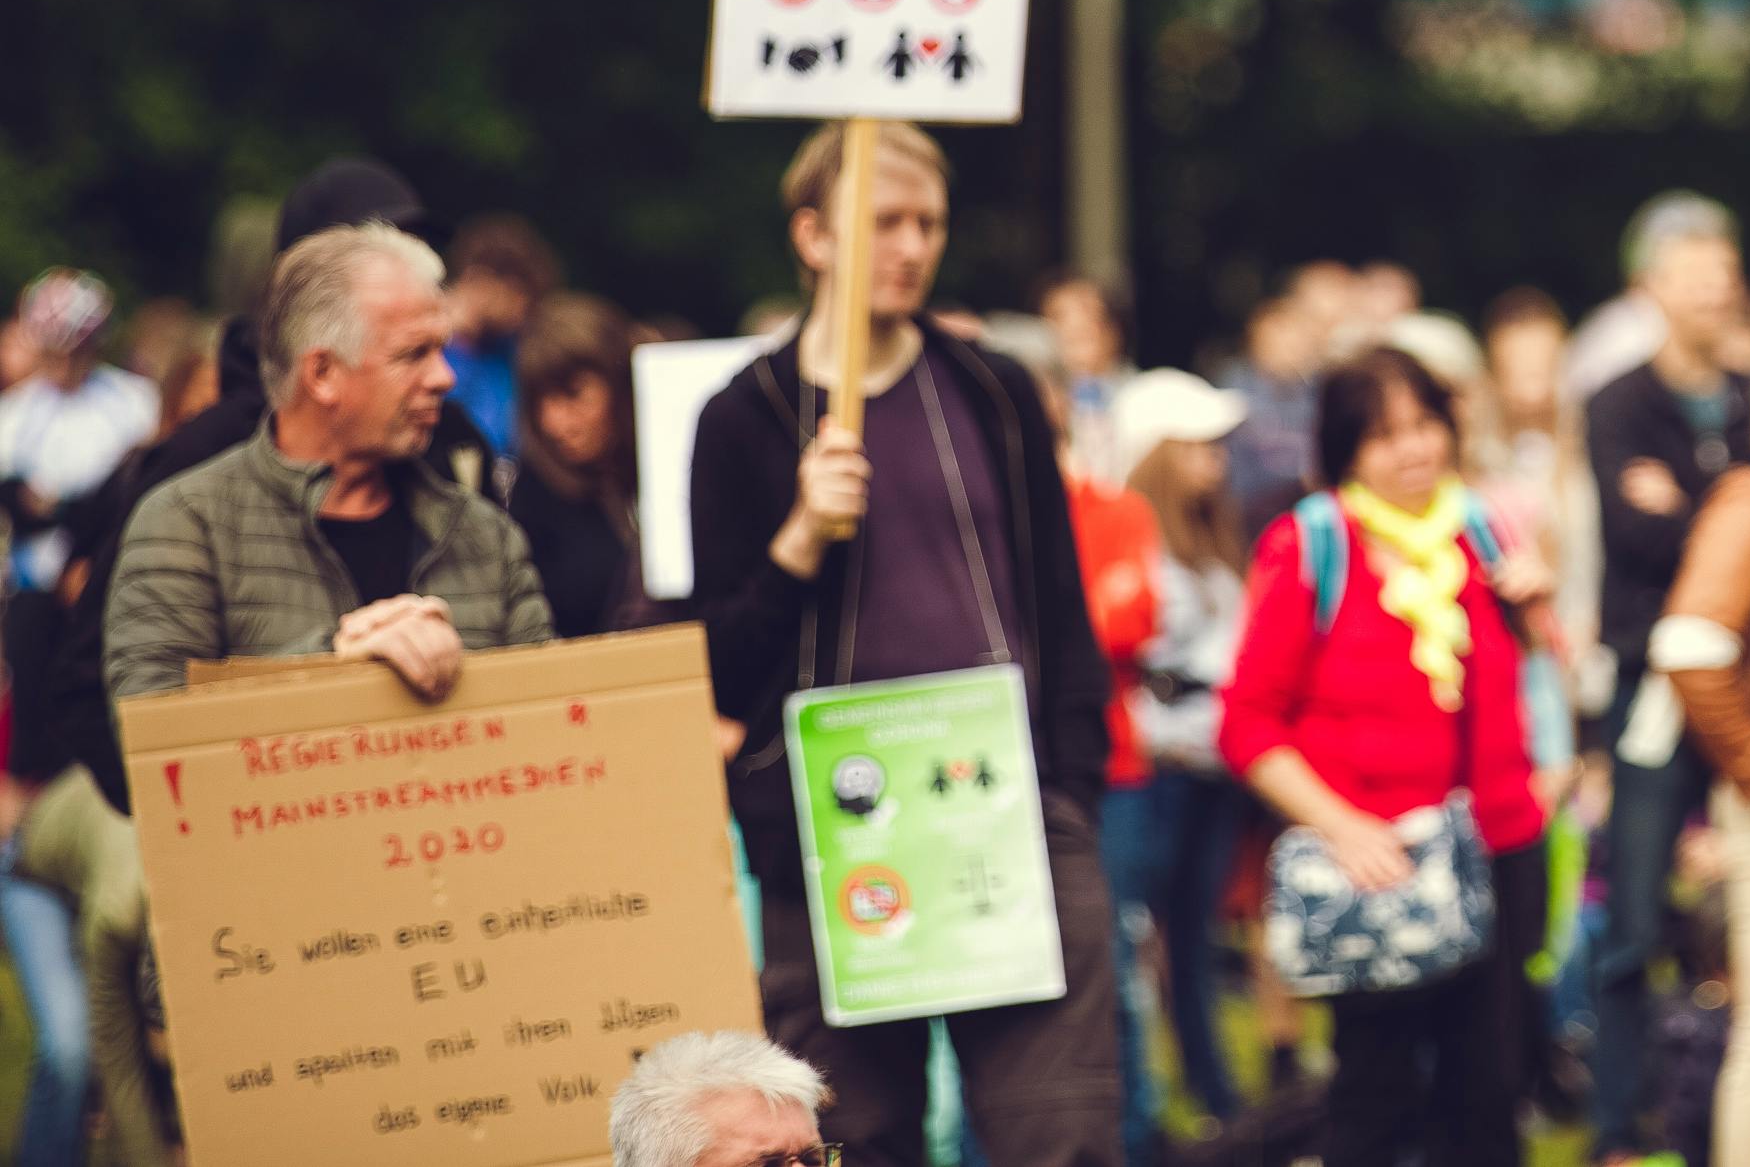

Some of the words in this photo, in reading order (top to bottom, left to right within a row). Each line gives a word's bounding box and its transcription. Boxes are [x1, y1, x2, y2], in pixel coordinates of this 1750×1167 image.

[240, 717, 506, 778] REGIERUNGEN
[211, 926, 276, 981] Sie
[299, 929, 382, 964] wollen
[394, 918, 456, 949] eine
[410, 957, 488, 1002] EU
[224, 1061, 274, 1094] und
